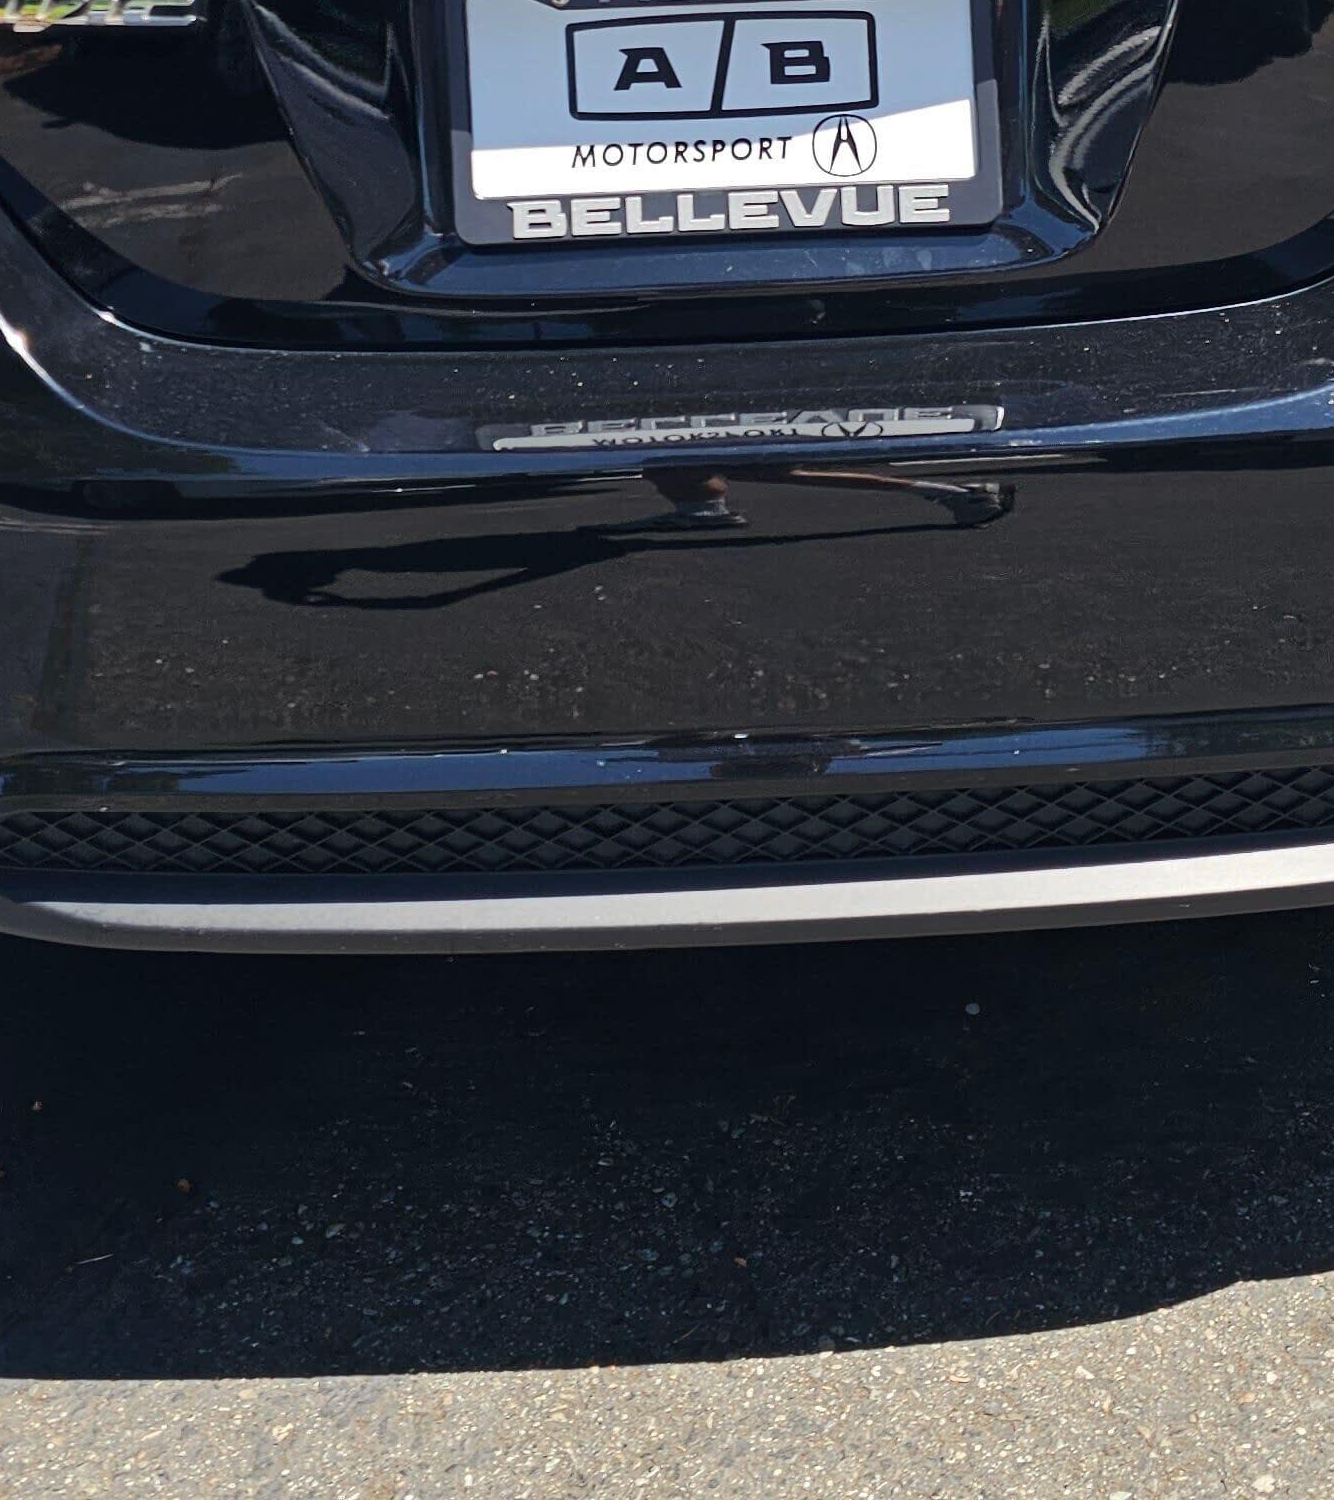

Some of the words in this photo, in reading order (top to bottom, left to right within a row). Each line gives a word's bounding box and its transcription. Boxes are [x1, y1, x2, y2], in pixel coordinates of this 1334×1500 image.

[613, 46, 683, 91] A
[760, 41, 831, 85] B
[571, 136, 794, 169] MOTORSPORT
[505, 183, 951, 241] BELLEVUE
